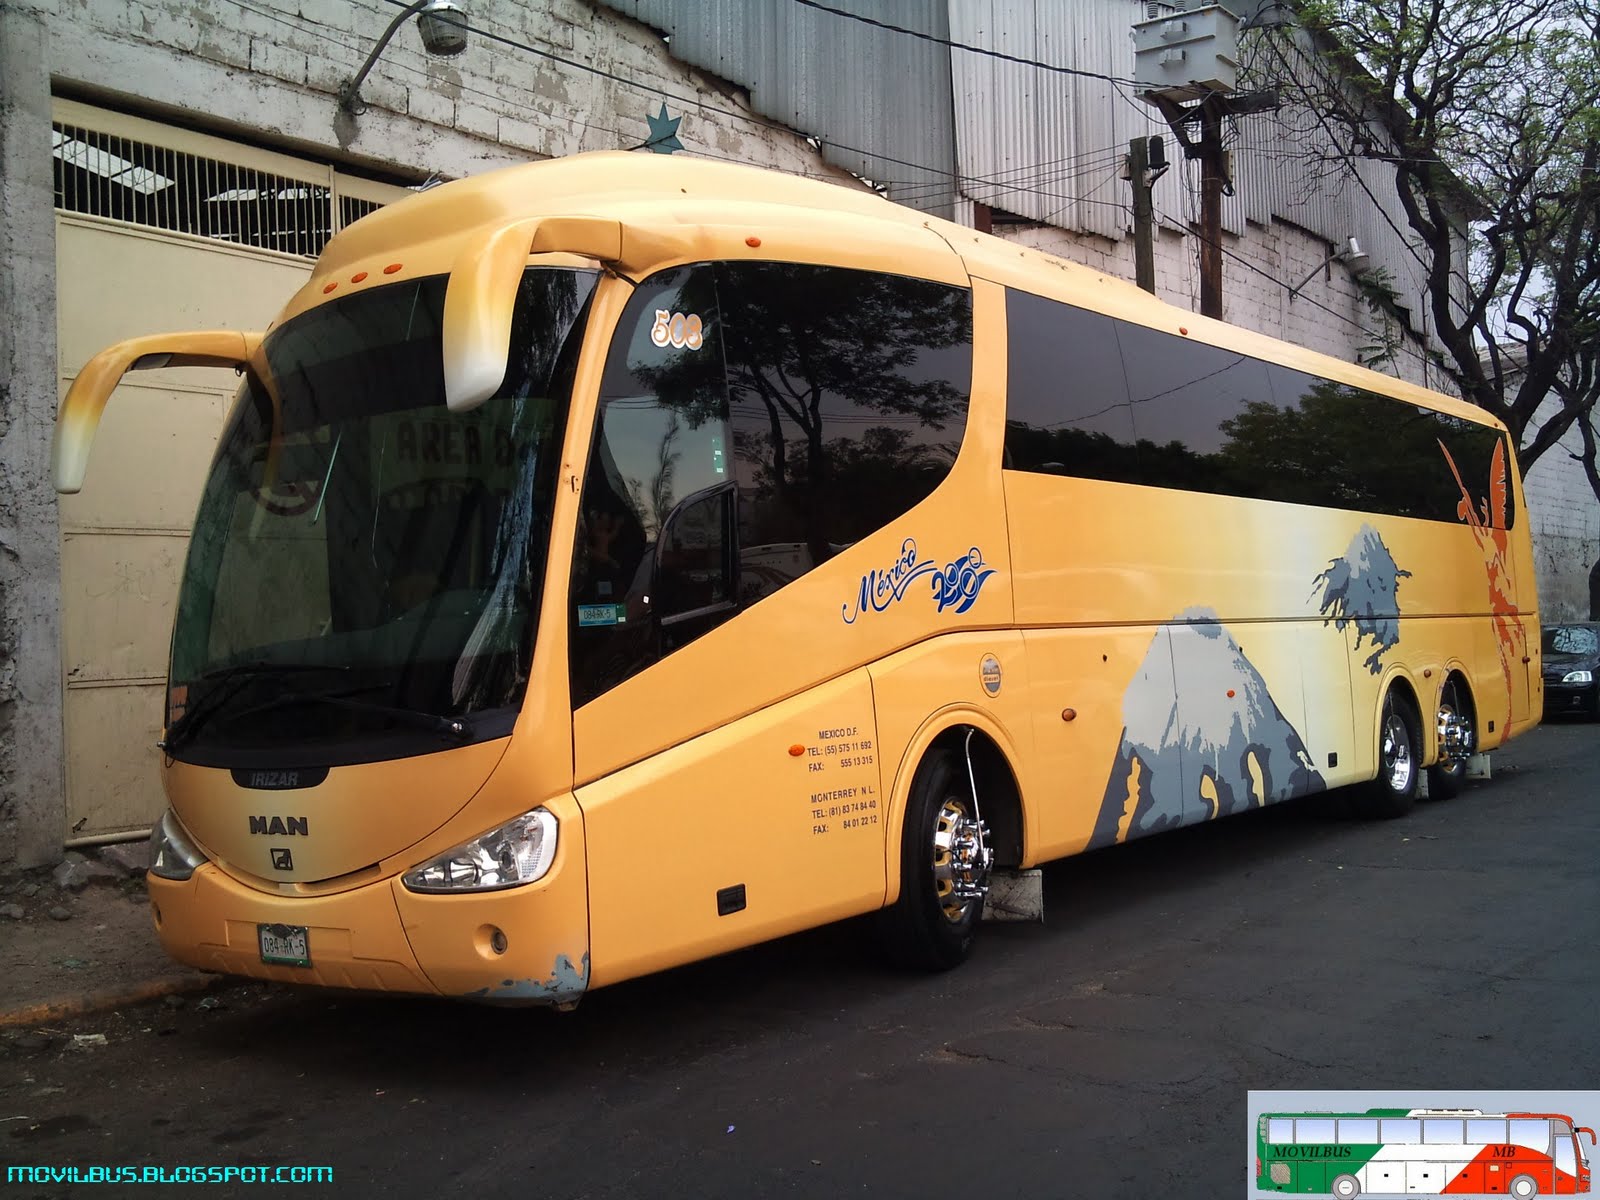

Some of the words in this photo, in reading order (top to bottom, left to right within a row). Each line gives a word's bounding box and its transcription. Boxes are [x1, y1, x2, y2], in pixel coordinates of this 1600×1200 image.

[842, 537, 938, 624] México
[819, 728, 845, 739] MEXICO
[807, 747, 823, 756] TEL:
[824, 745, 837, 756] (55)
[839, 743, 850, 753] 575
[852, 742, 859, 751] 11
[808, 762, 824, 772] FAX:
[840, 758, 852, 768] 555
[853, 757, 861, 766] 13
[862, 756, 873, 765] 315
[251, 771, 299, 787] IRIZAR
[811, 788, 857, 803] MONTERREY
[812, 809, 828, 819] TEL:
[829, 806, 841, 818] (81)
[842, 804, 850, 814] 83
[851, 803, 859, 812] 74
[868, 800, 877, 809] 40
[249, 816, 309, 836] MAN
[813, 824, 829, 835] FAX:
[843, 819, 851, 829] 84
[852, 818, 859, 828] 01
[861, 817, 869, 826] 22
[870, 815, 877, 824] 12
[263, 937, 305, 956] 084-RK-5
